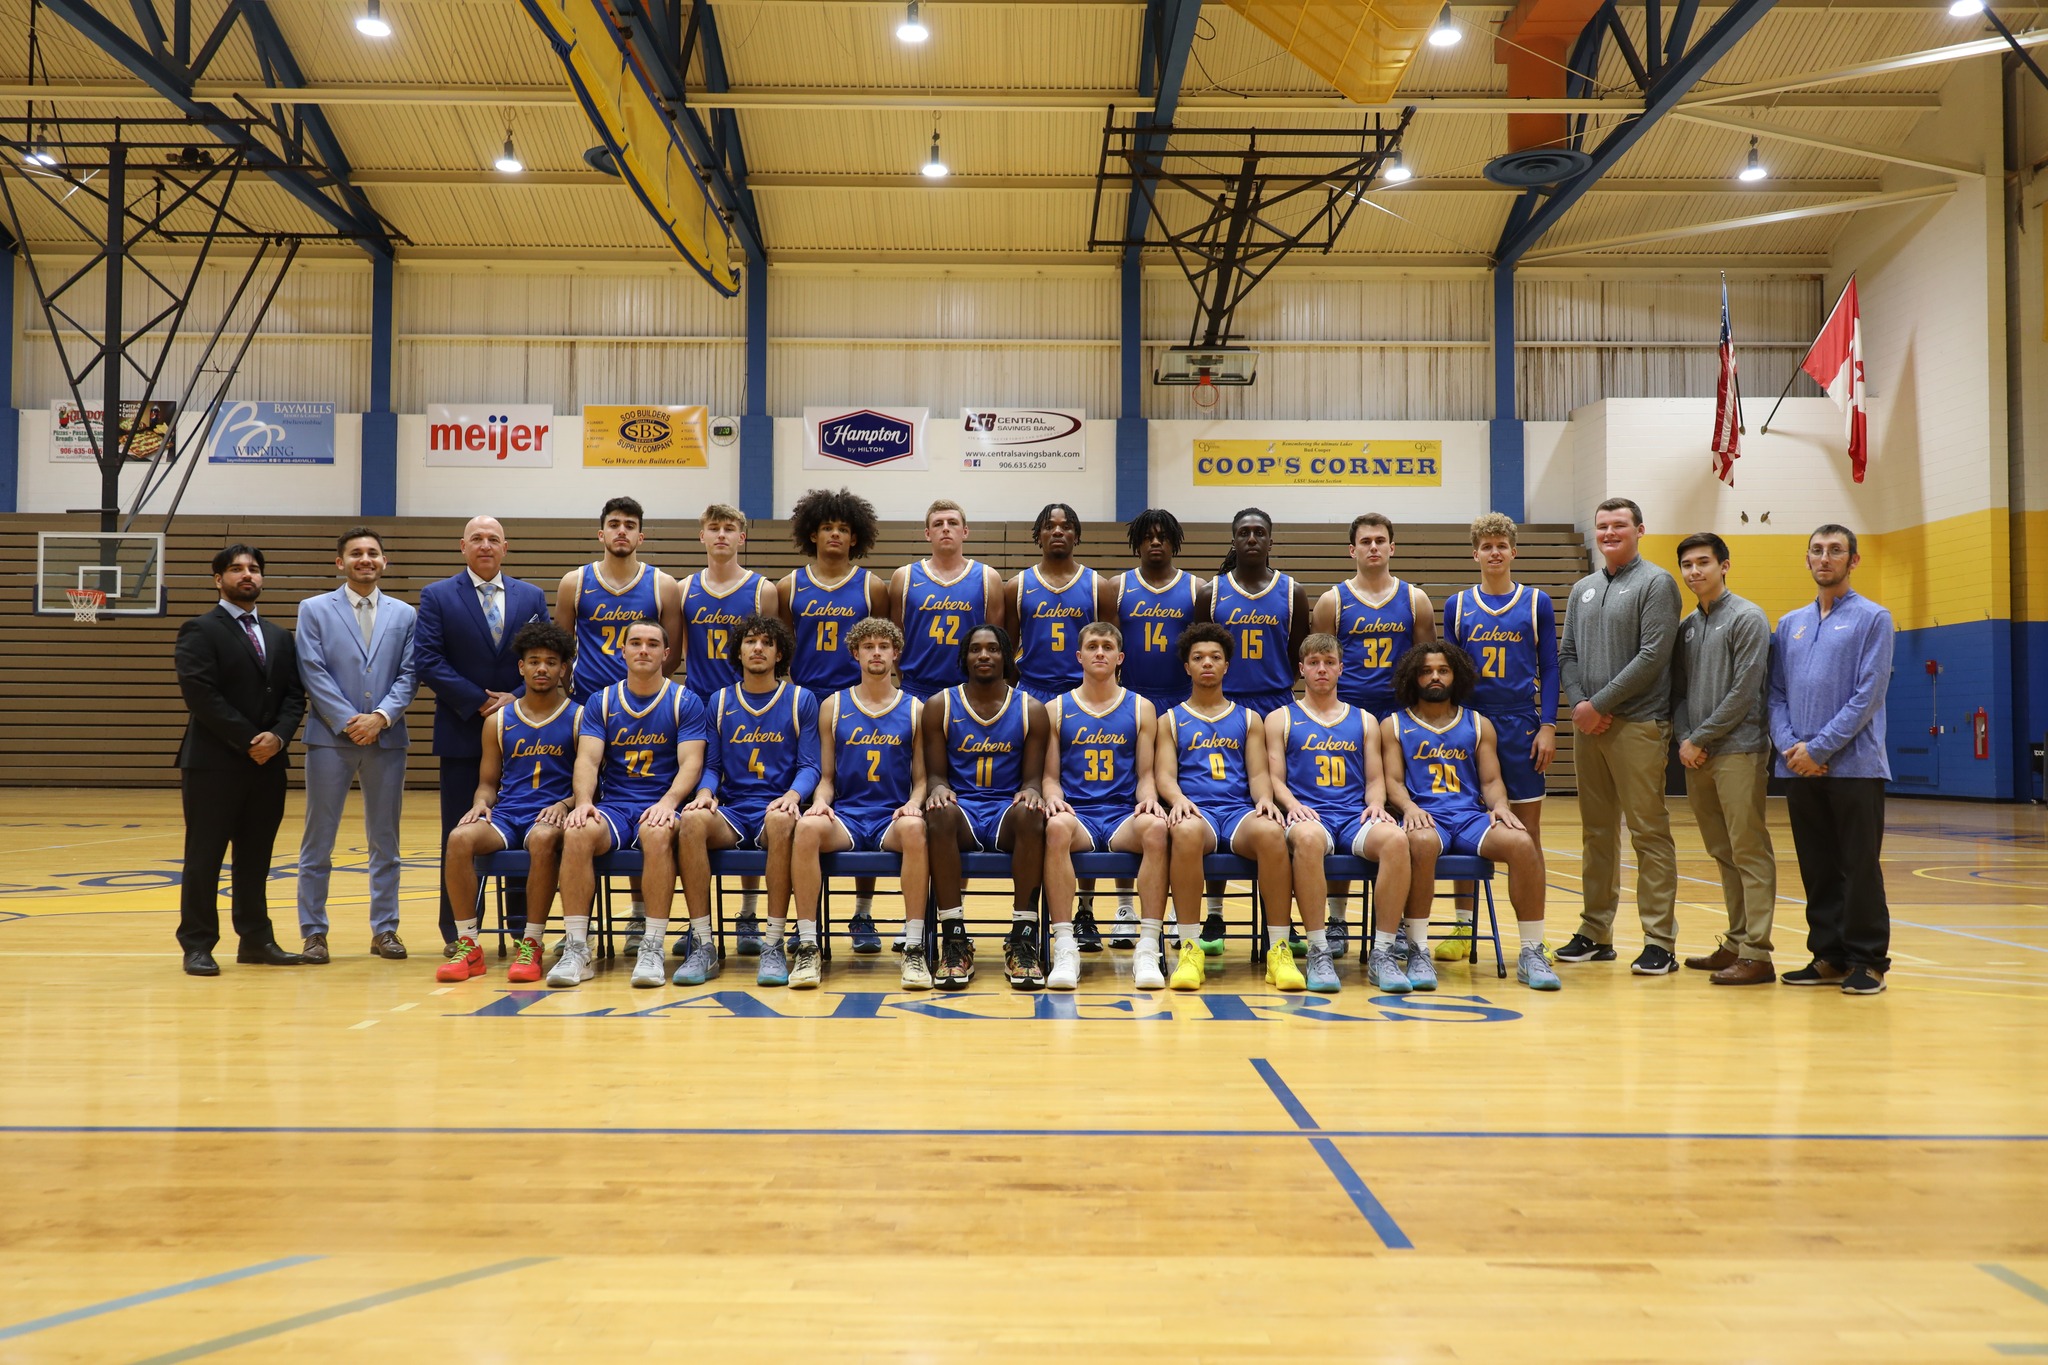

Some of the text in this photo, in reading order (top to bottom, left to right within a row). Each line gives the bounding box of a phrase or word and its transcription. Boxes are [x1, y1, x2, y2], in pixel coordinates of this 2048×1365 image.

[620, 409, 671, 422] SOO BUILDERS
[430, 414, 549, 460] meijer
[628, 424, 663, 438] SBS
[824, 424, 908, 446] Hampton
[232, 445, 294, 457] WINNING
[617, 438, 674, 453] SUPPLY COMPANY
[847, 446, 857, 454] by
[965, 450, 1080, 459] www.centralsavingsbank.com
[998, 461, 1047, 469] 906.635.6250
[1197, 457, 1437, 475] COOP'S CORNER
[589, 603, 646, 621] Lakers
[800, 599, 855, 617] Lakers
[919, 594, 971, 611] Lakers
[1032, 601, 1083, 619] Lakers
[1129, 601, 1183, 618] Lakers
[691, 606, 742, 625] Lakers
[1225, 607, 1279, 625] Lakers
[928, 615, 960, 646] 42
[1349, 617, 1405, 635] Lakers
[1467, 623, 1522, 643] Lakers
[707, 628, 728, 660] 12
[815, 621, 839, 652] 13
[1051, 622, 1065, 652] 5
[1144, 621, 1168, 653] 14
[1241, 629, 1263, 660] 15
[1363, 637, 1393, 669] 32
[1481, 646, 1506, 678] 21
[610, 727, 667, 747] Lakers
[729, 724, 784, 744] Lakers
[845, 727, 902, 746] Lakers
[957, 733, 1014, 753] Lakers
[1071, 727, 1127, 745] Lakers
[1187, 731, 1239, 751] Lakers
[1301, 734, 1357, 752] Lakers
[511, 738, 563, 759] Lakers
[1413, 741, 1467, 761] Lakers
[624, 749, 655, 778] 22
[748, 747, 765, 779] 4
[866, 749, 881, 782] 2
[976, 756, 994, 787] 11
[1084, 749, 1114, 782] 33
[1209, 753, 1226, 780] 0
[1315, 755, 1346, 787] 30
[532, 761, 542, 789] 1
[1428, 763, 1461, 793] 20
[441, 989, 1524, 1023] LAKERS
